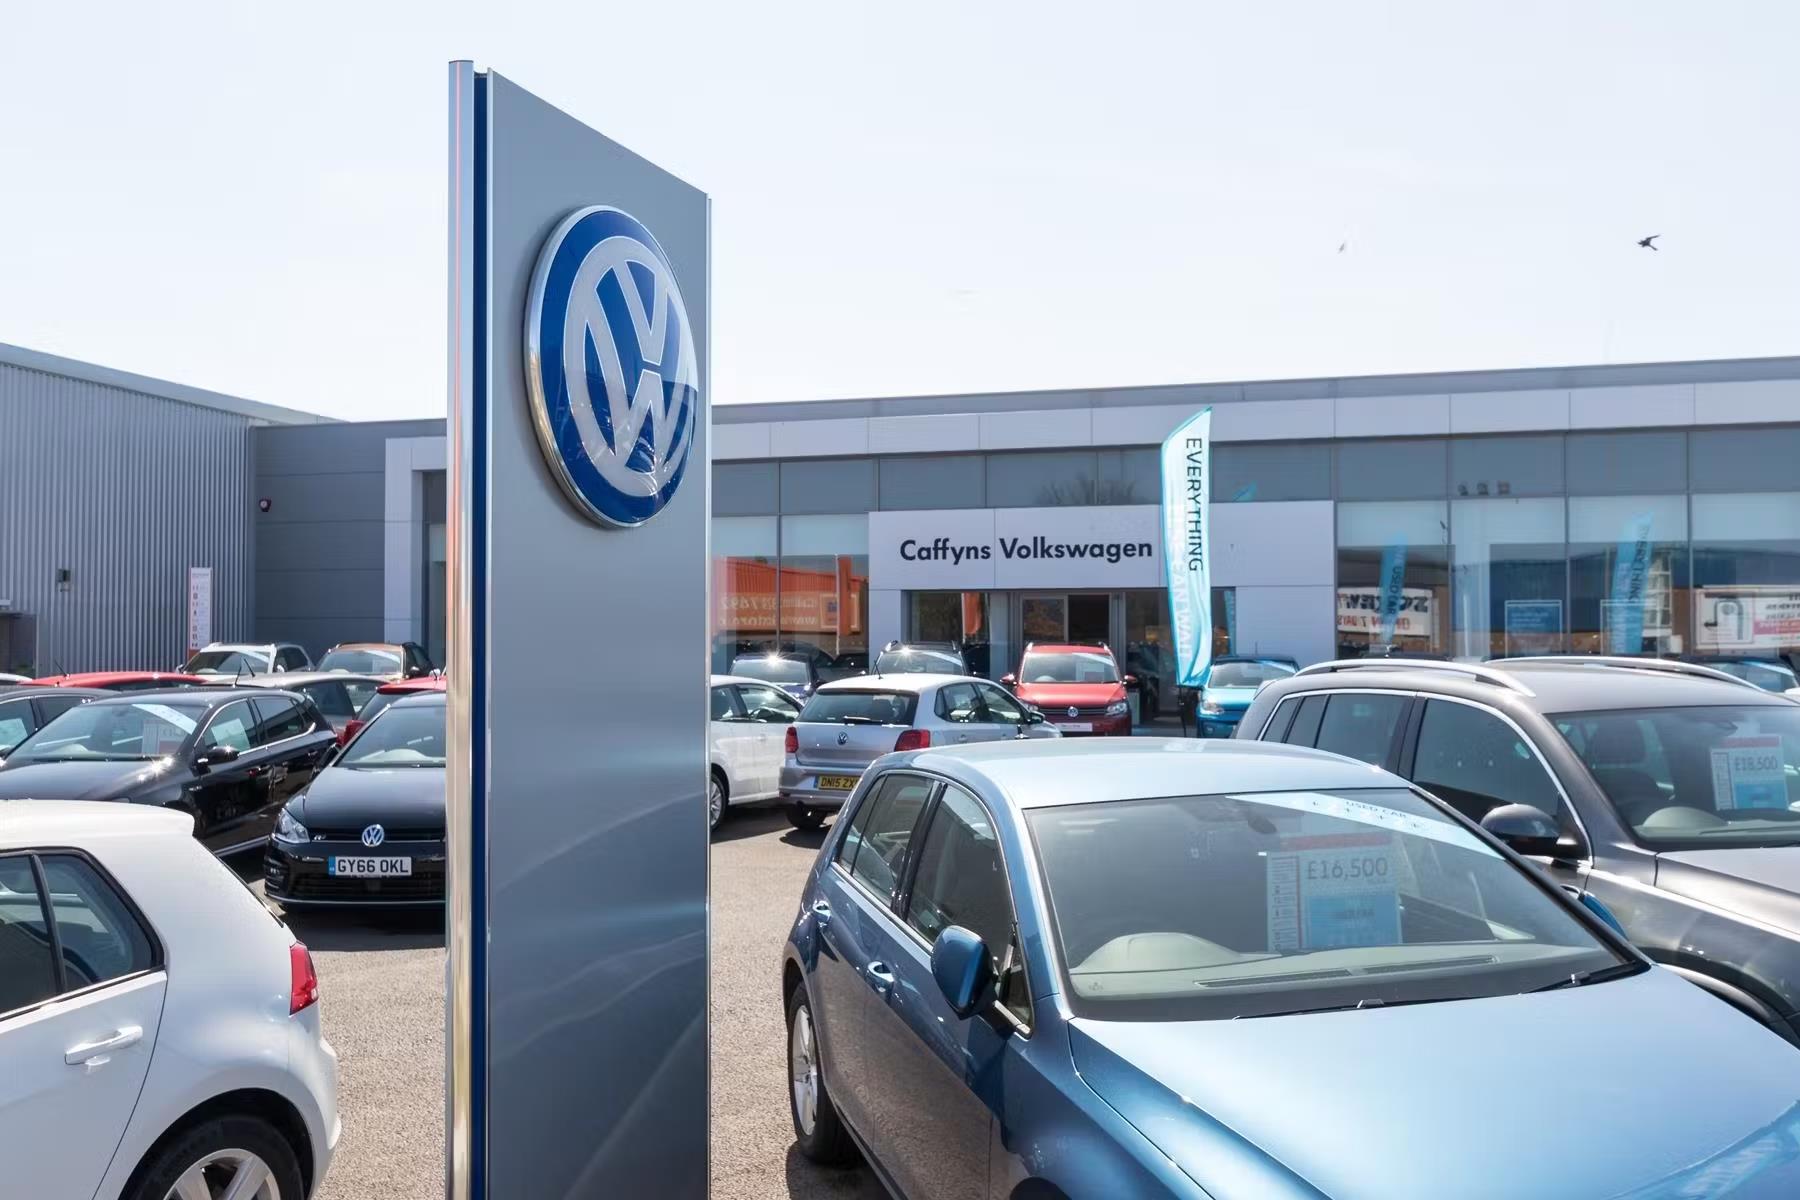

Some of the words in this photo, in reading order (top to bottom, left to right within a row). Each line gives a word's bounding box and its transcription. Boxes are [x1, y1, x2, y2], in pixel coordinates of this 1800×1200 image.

[563, 236, 696, 497] VW
[1186, 437, 1204, 572] EVERYTHING
[900, 537, 991, 566] Caffyns
[999, 536, 1153, 564] Volkswagen
[842, 776, 858, 789] ZX
[337, 859, 376, 873] GY66
[380, 859, 409, 873] OKL
[1307, 857, 1389, 882] £16,500
